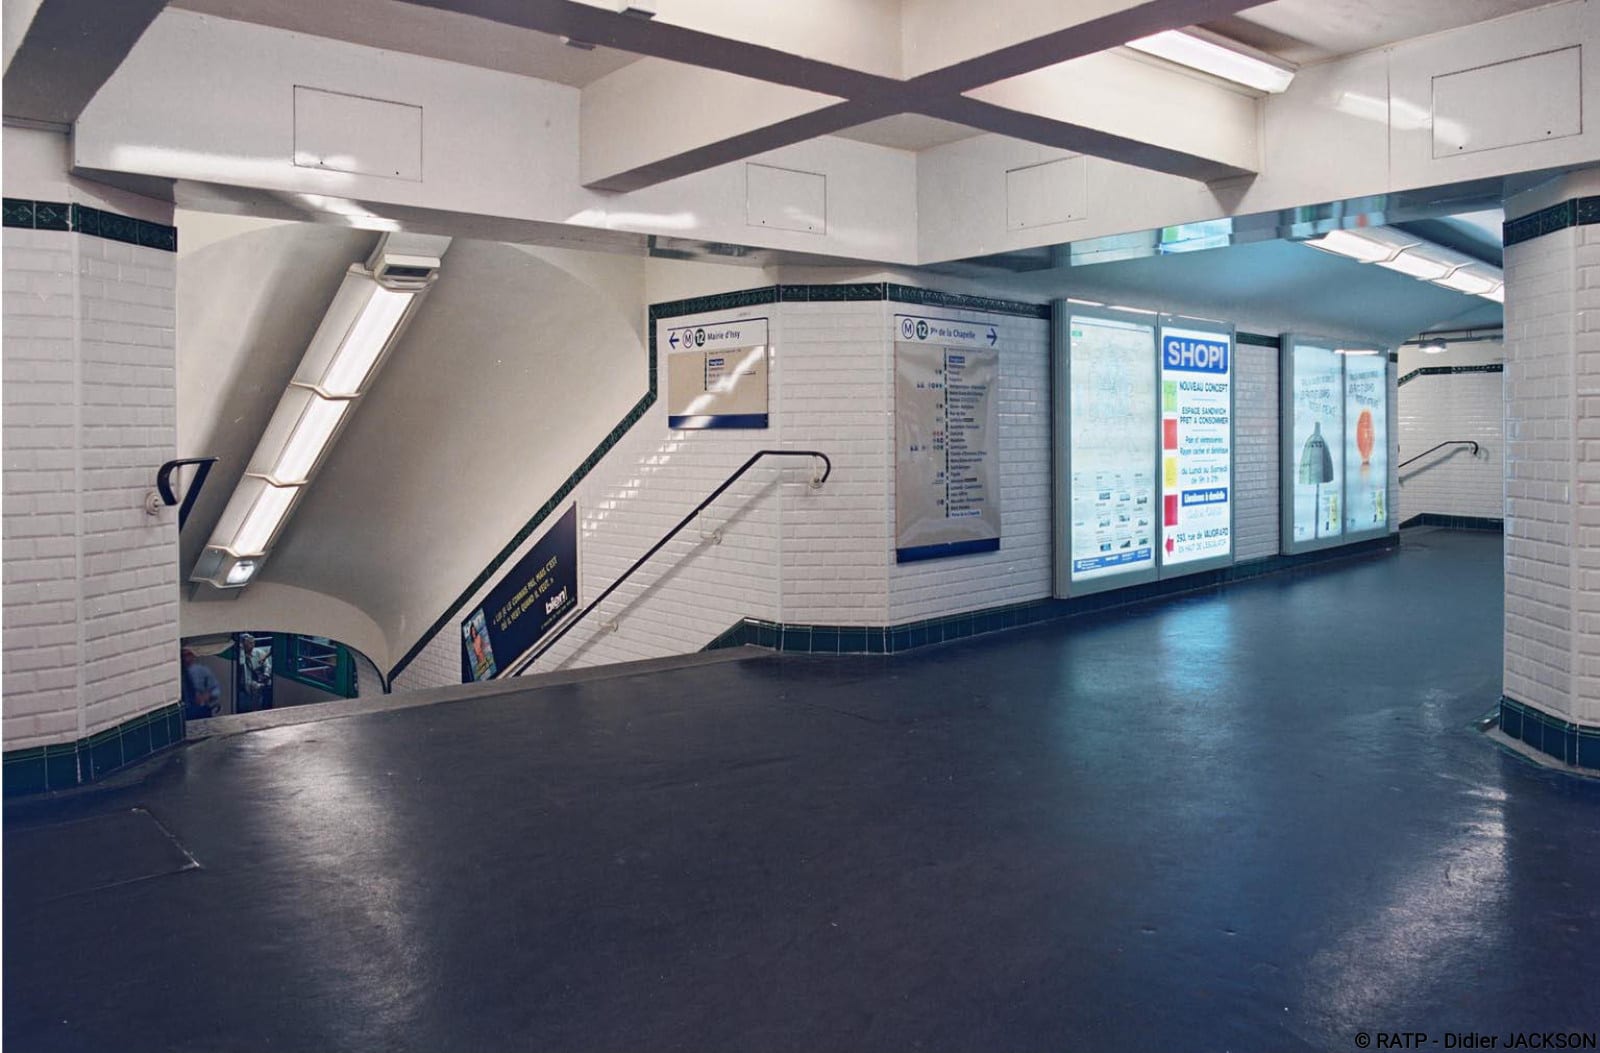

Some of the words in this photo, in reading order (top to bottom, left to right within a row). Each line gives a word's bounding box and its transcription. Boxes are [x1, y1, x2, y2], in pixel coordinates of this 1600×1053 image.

[696, 331, 705, 345] 12
[707, 332, 724, 341] Mairie
[725, 330, 741, 340] d'Issy
[916, 322, 928, 338] 12
[939, 328, 946, 336] de
[946, 328, 952, 337] la
[953, 329, 976, 340] Chapelle
[1167, 340, 1225, 369] SHOPI
[1179, 380, 1204, 392] NOUVEAU
[1205, 383, 1228, 393] CONCEPT
[1181, 406, 1200, 415] ESPACE
[1201, 406, 1226, 415] SANDWICH
[1199, 416, 1229, 424] CONSOMMER
